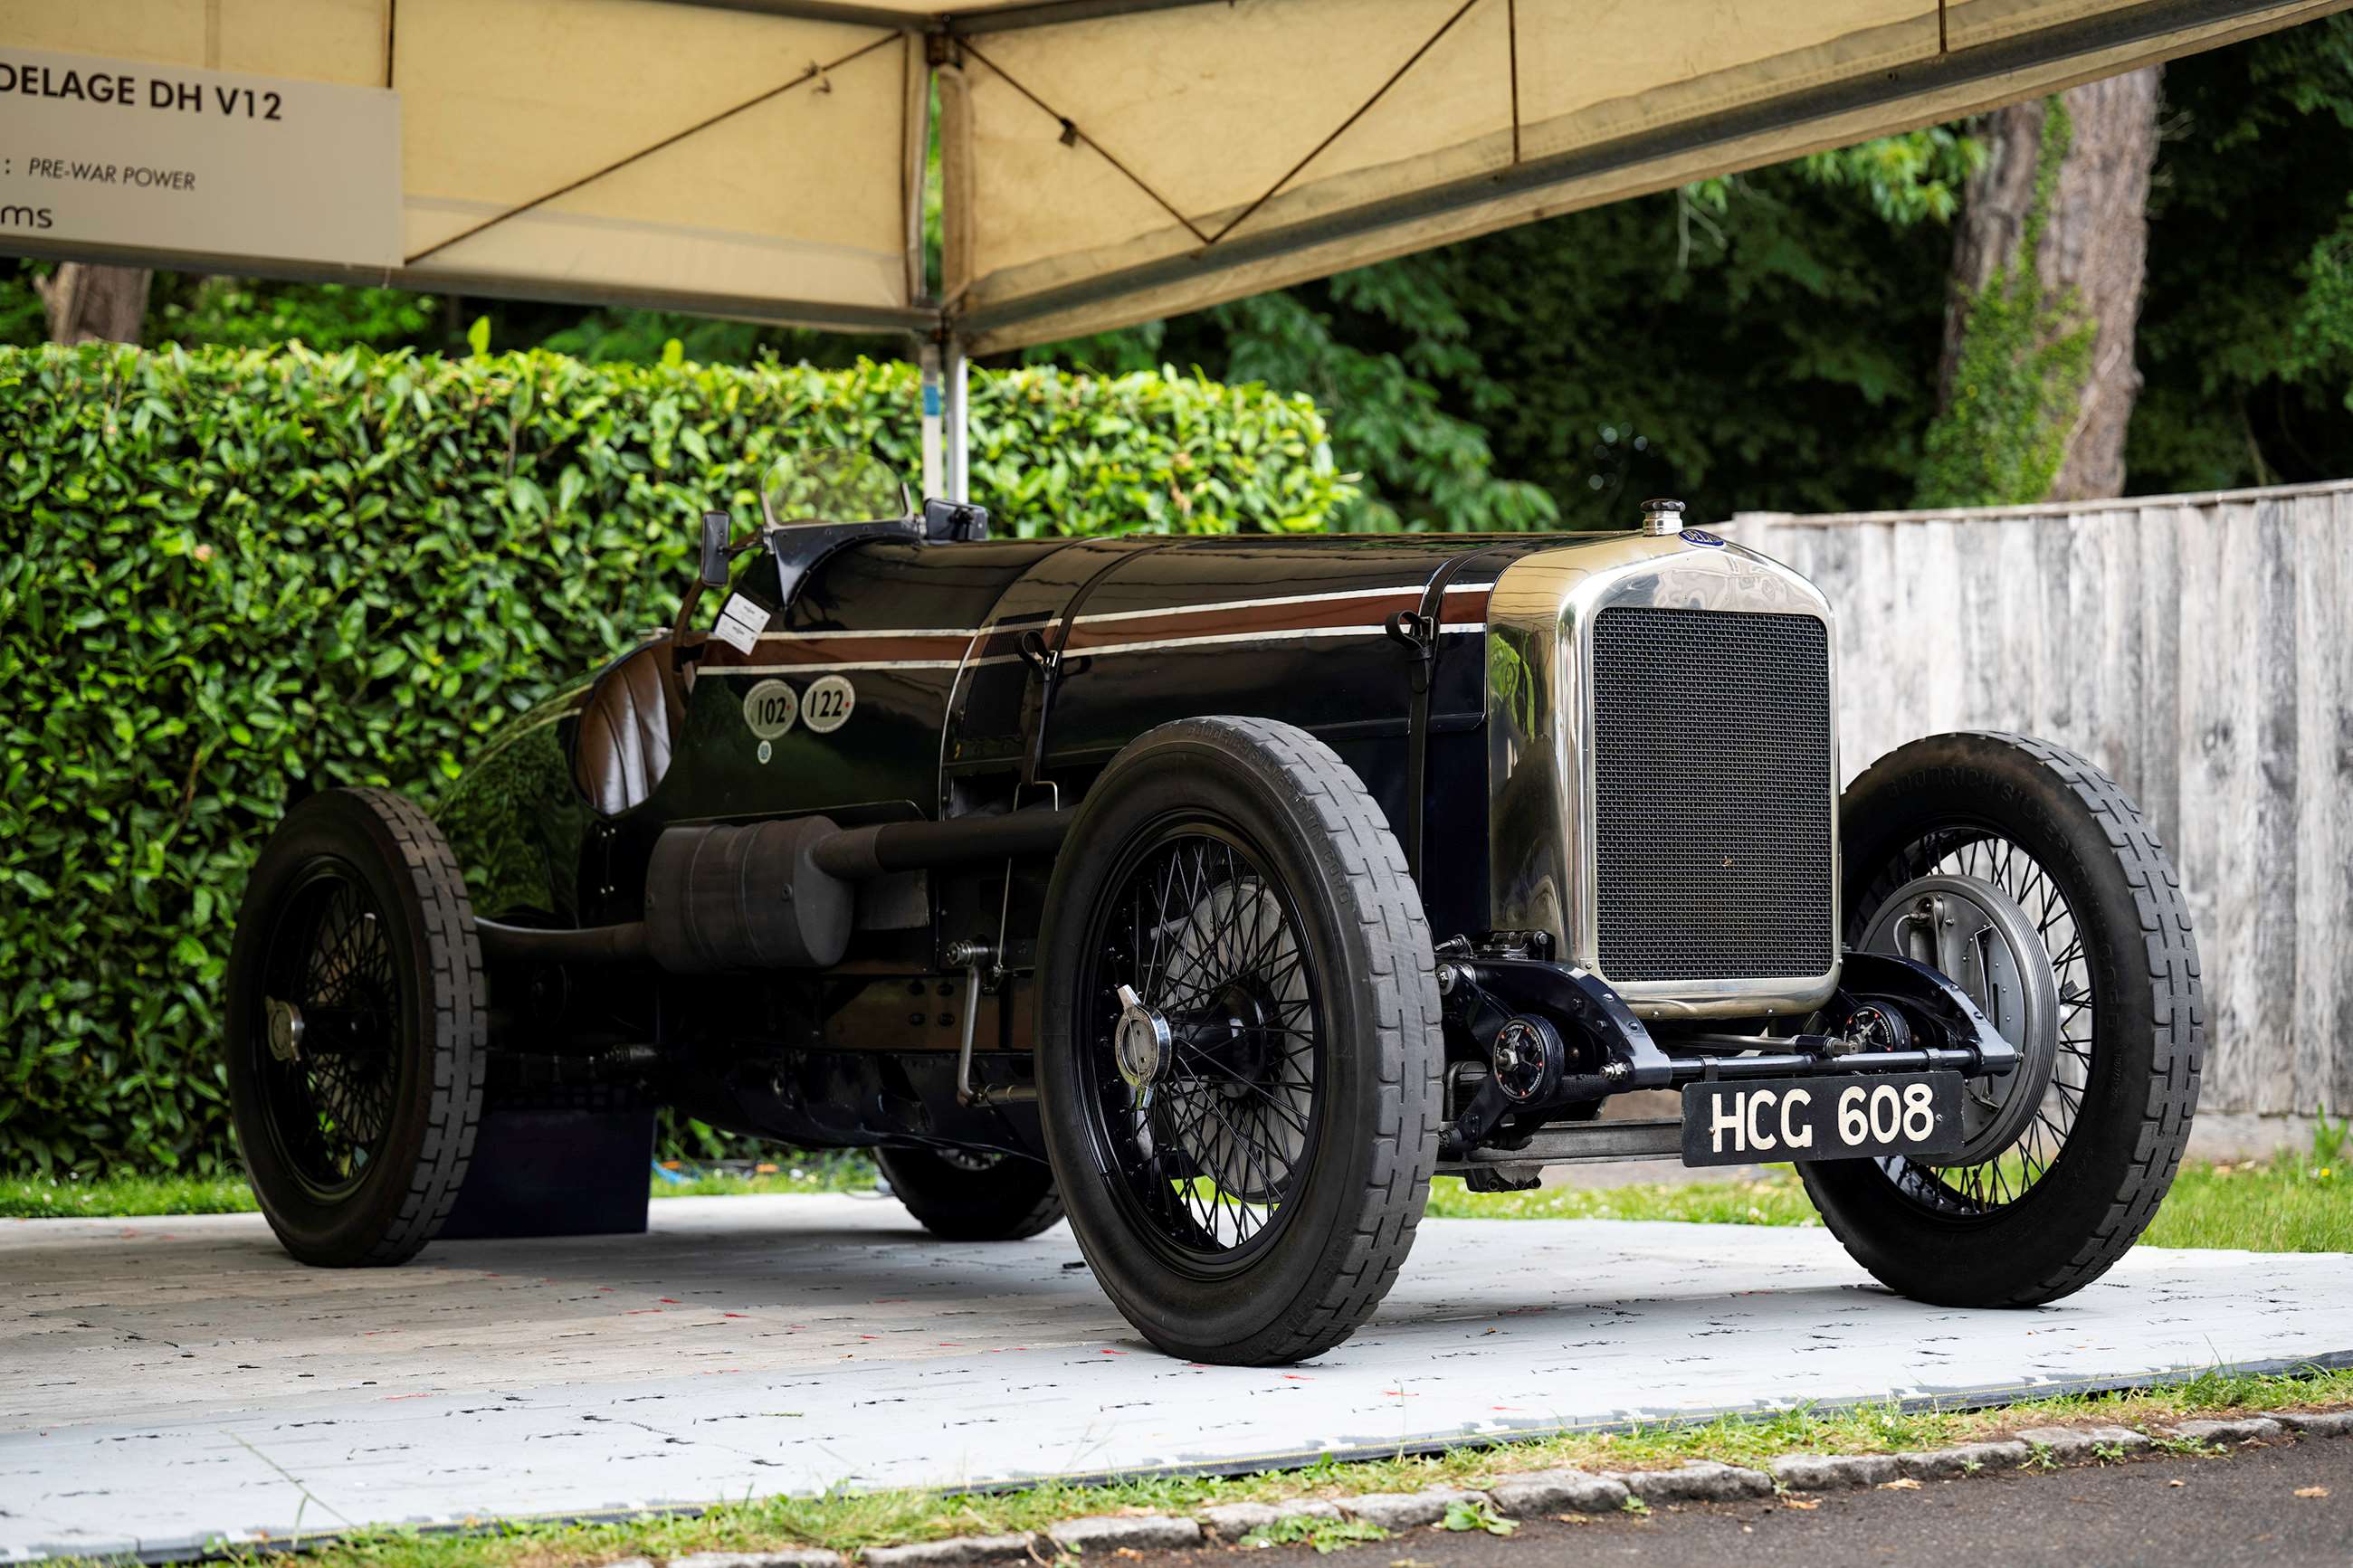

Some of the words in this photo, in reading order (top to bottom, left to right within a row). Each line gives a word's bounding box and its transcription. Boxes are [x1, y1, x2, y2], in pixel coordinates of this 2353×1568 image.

[0, 62, 135, 106] DELAGE
[149, 80, 203, 112] DH
[215, 86, 282, 120] V12
[29, 157, 117, 183] PRE-WAR
[123, 166, 195, 191] POWER
[758, 697, 787, 726] 102
[810, 690, 843, 717] 122
[1711, 1088, 1813, 1153] HCG
[1837, 1083, 1934, 1145] 608
